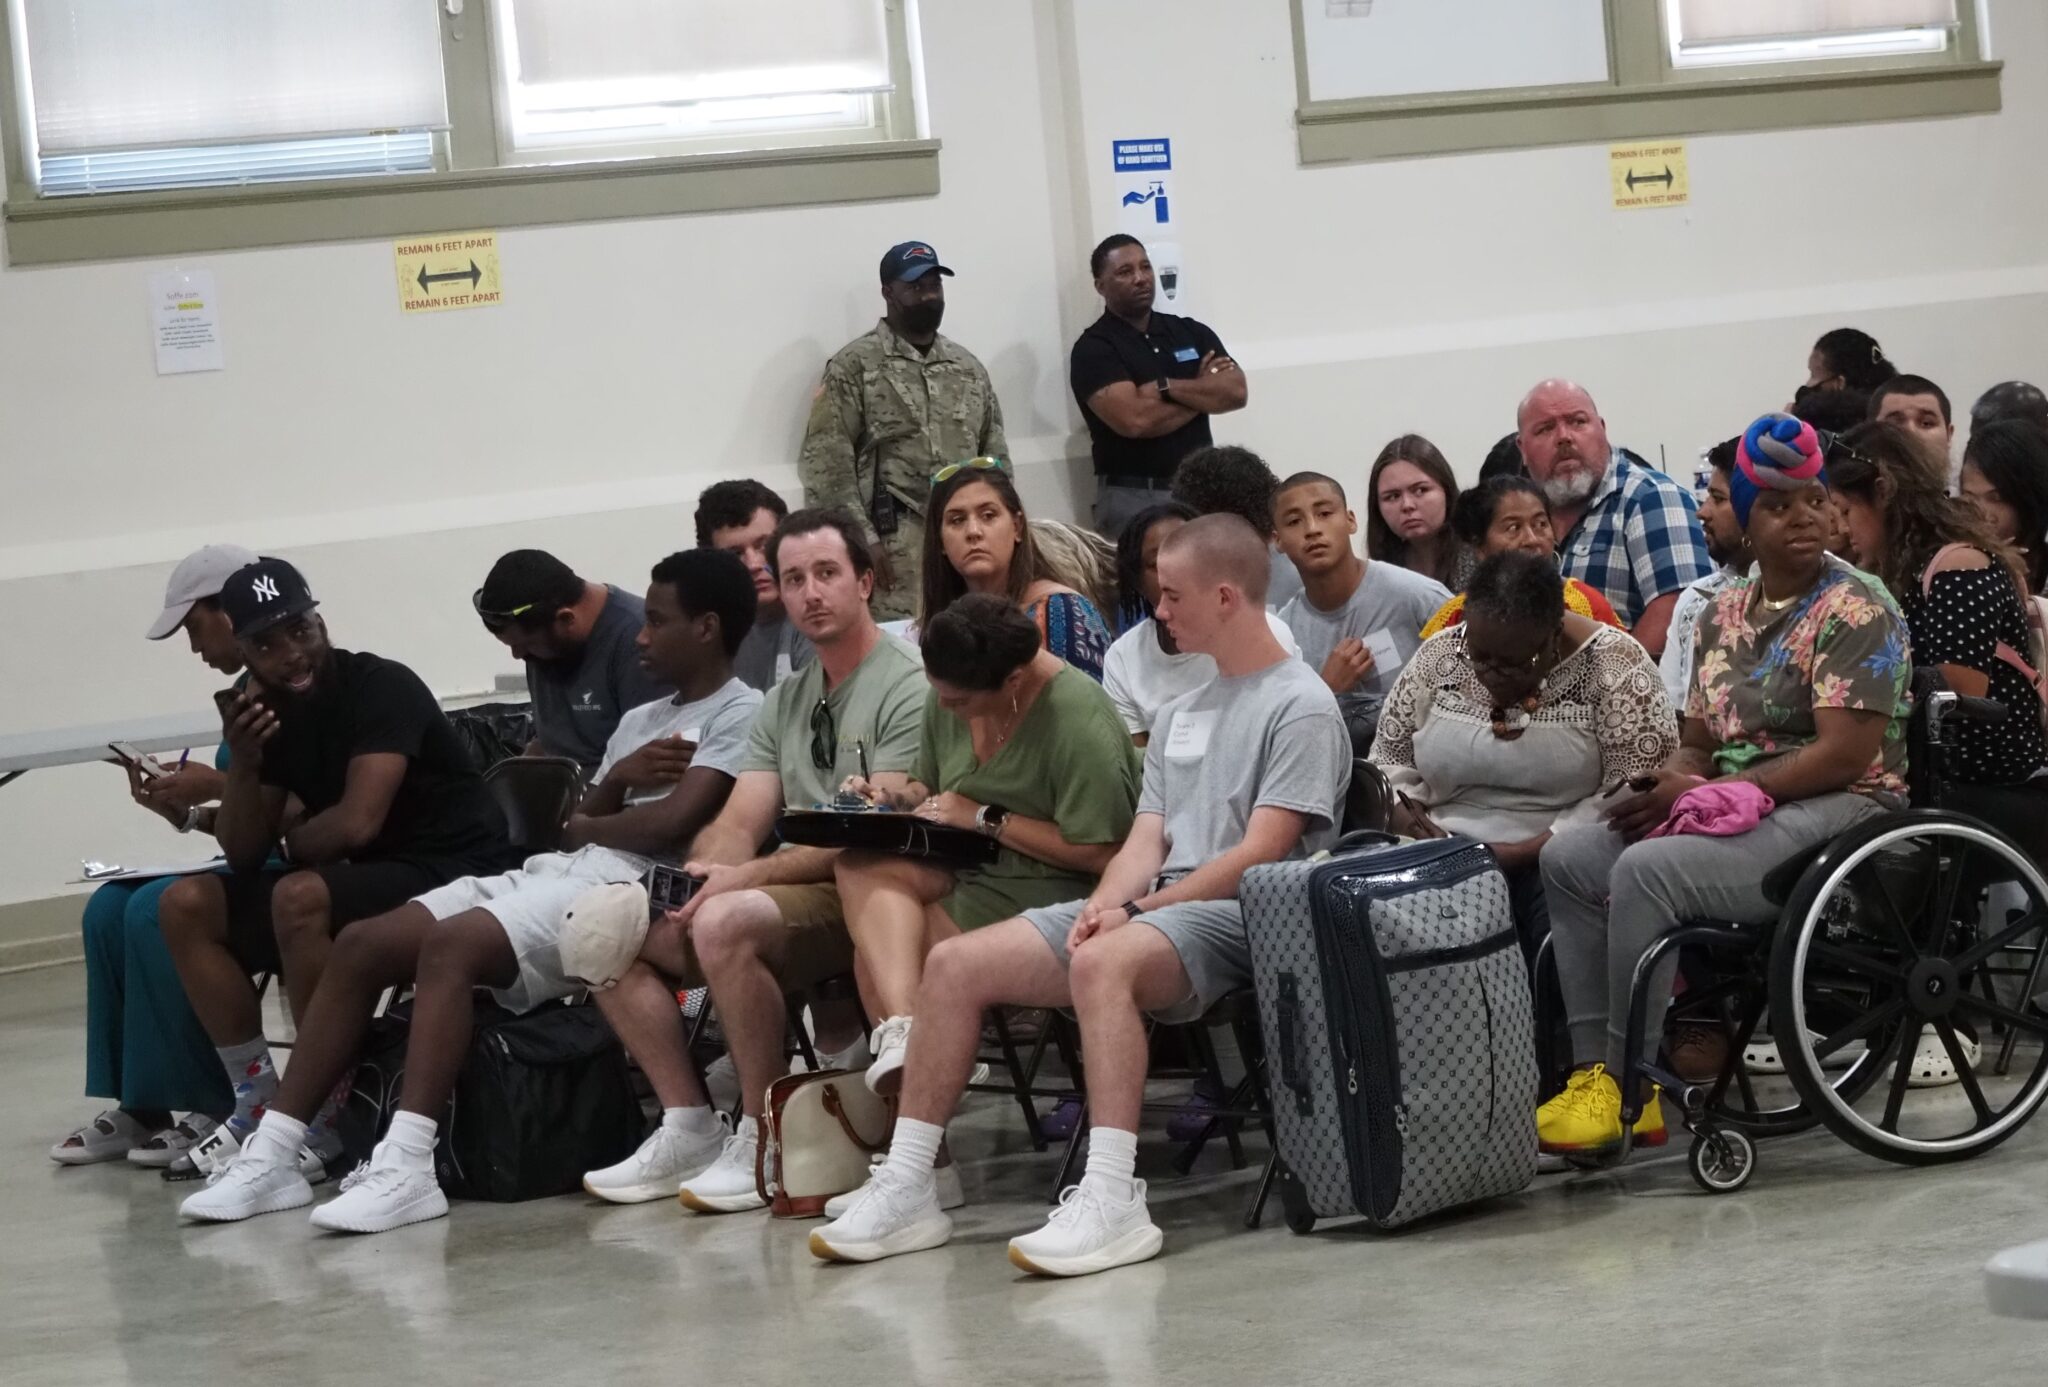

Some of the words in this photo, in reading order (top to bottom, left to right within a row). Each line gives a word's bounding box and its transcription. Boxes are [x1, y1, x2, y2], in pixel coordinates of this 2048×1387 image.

[1611, 150, 1638, 159] REMAIN
[1645, 148, 1660, 157] FEET
[1661, 146, 1682, 155] APART
[1615, 197, 1642, 206] REMAIN
[1649, 195, 1665, 204] FEET
[1666, 193, 1687, 202] APART
[397, 244, 433, 256] REMAIN
[435, 242, 441, 252] 6
[442, 241, 462, 251] FEET
[464, 238, 493, 249] APART
[405, 298, 441, 310] REMAIN
[442, 297, 449, 306] 6
[450, 295, 470, 305] FEET
[472, 292, 500, 302] APART
[252, 574, 281, 603] NY
